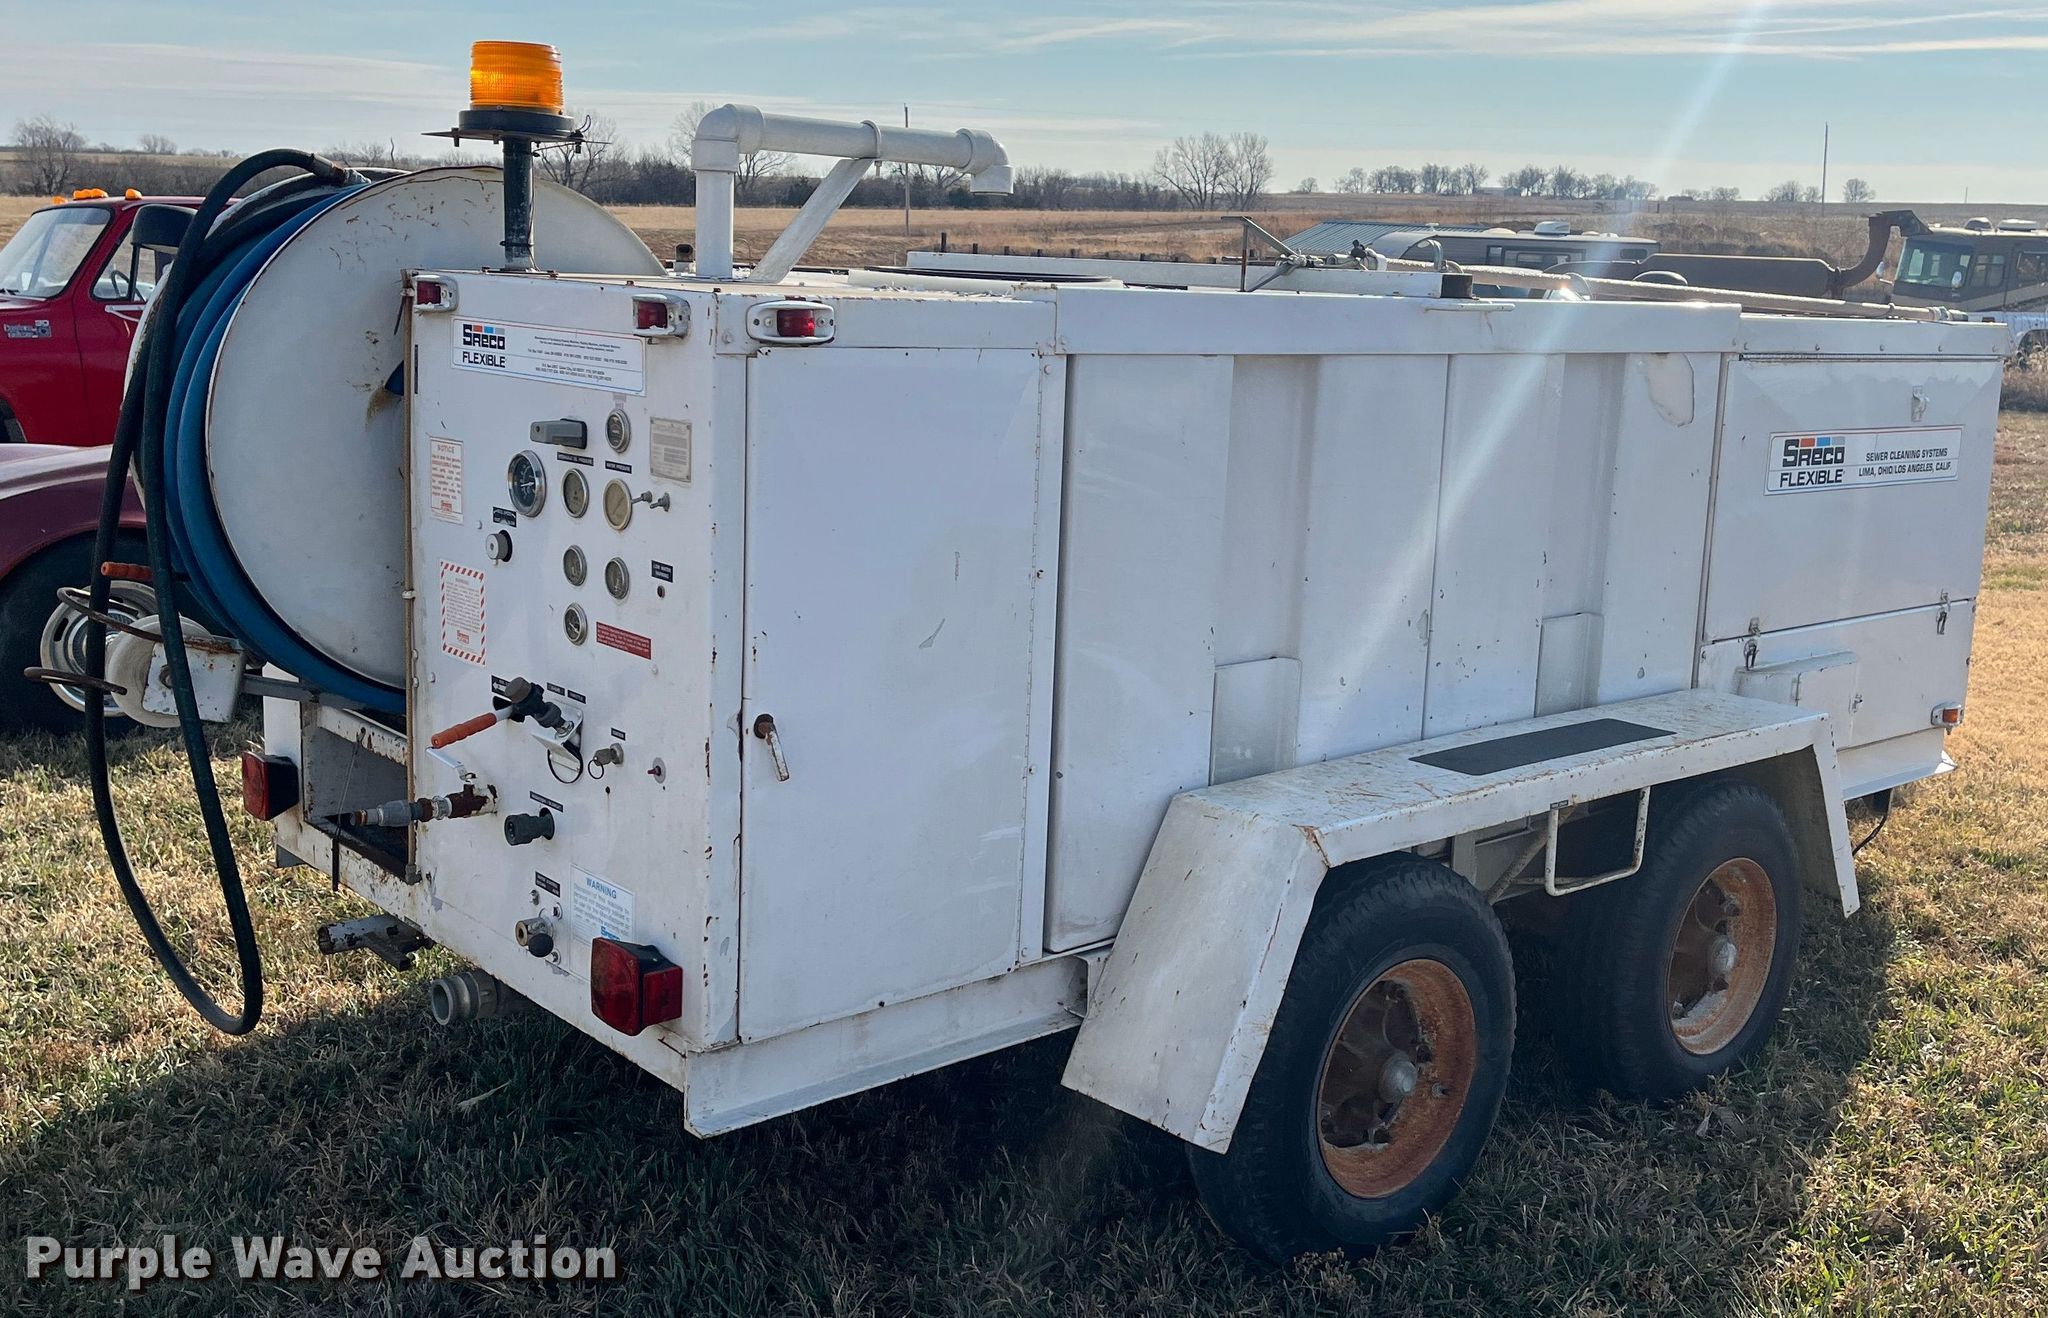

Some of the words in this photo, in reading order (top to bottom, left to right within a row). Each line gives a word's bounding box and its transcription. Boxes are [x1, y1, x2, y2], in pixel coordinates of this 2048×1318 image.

[463, 351, 506, 368] FLEXIBLE
[1866, 452, 1889, 462] SEWER
[1889, 450, 1921, 460] CLEANING
[1921, 448, 1948, 459] SYSTEMS
[1780, 469, 1843, 488] FLEXIBLE
[1859, 467, 1876, 477] LIMA,
[1894, 465, 1907, 474] LOS
[586, 877, 617, 899] WARNING
